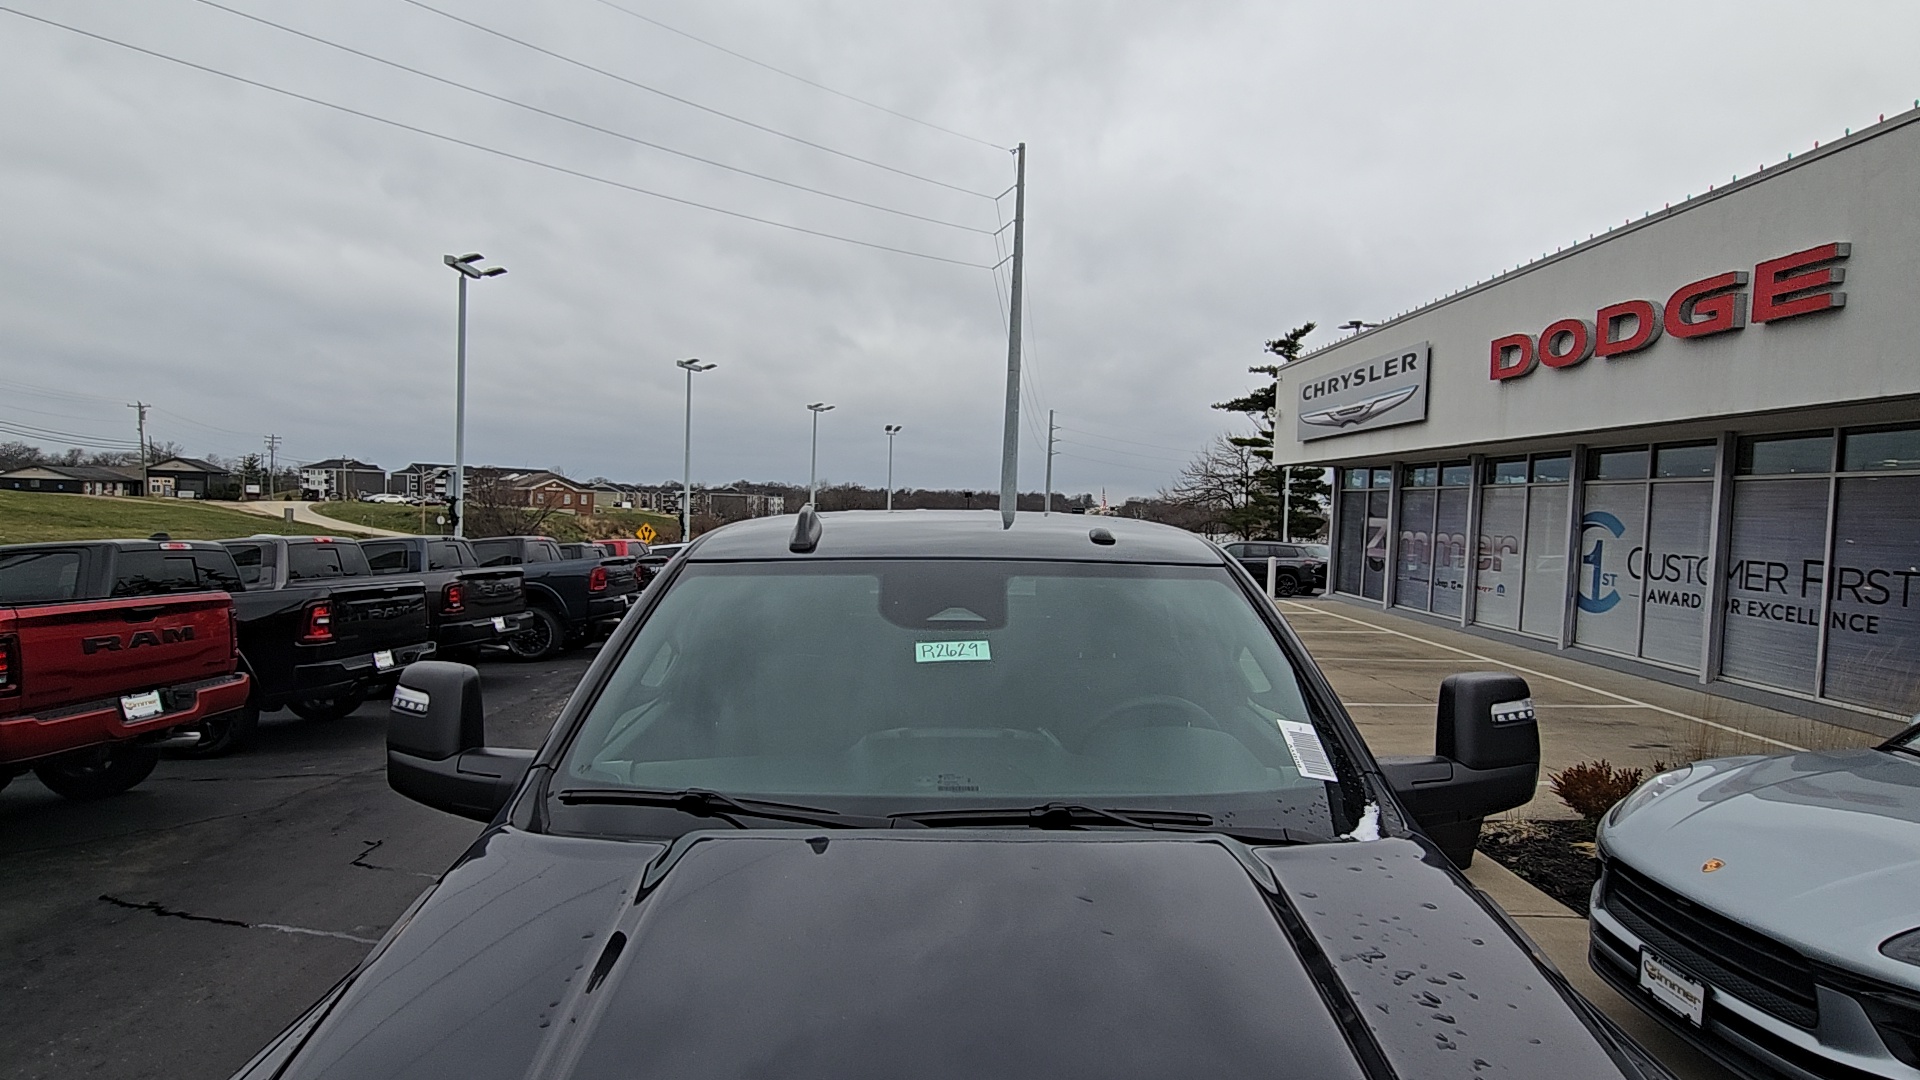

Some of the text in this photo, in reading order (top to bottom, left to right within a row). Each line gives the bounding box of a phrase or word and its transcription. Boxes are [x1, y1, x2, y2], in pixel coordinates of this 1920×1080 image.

[1490, 242, 1851, 380] DODGE
[1302, 352, 1418, 401] CHRYSLER
[1366, 516, 1519, 572] Zmmer
[1801, 559, 1920, 608] FIRST
[1647, 588, 1702, 609] AWARD
[1746, 600, 1881, 635] EXCELLNCE
[81, 624, 196, 656] RAM
